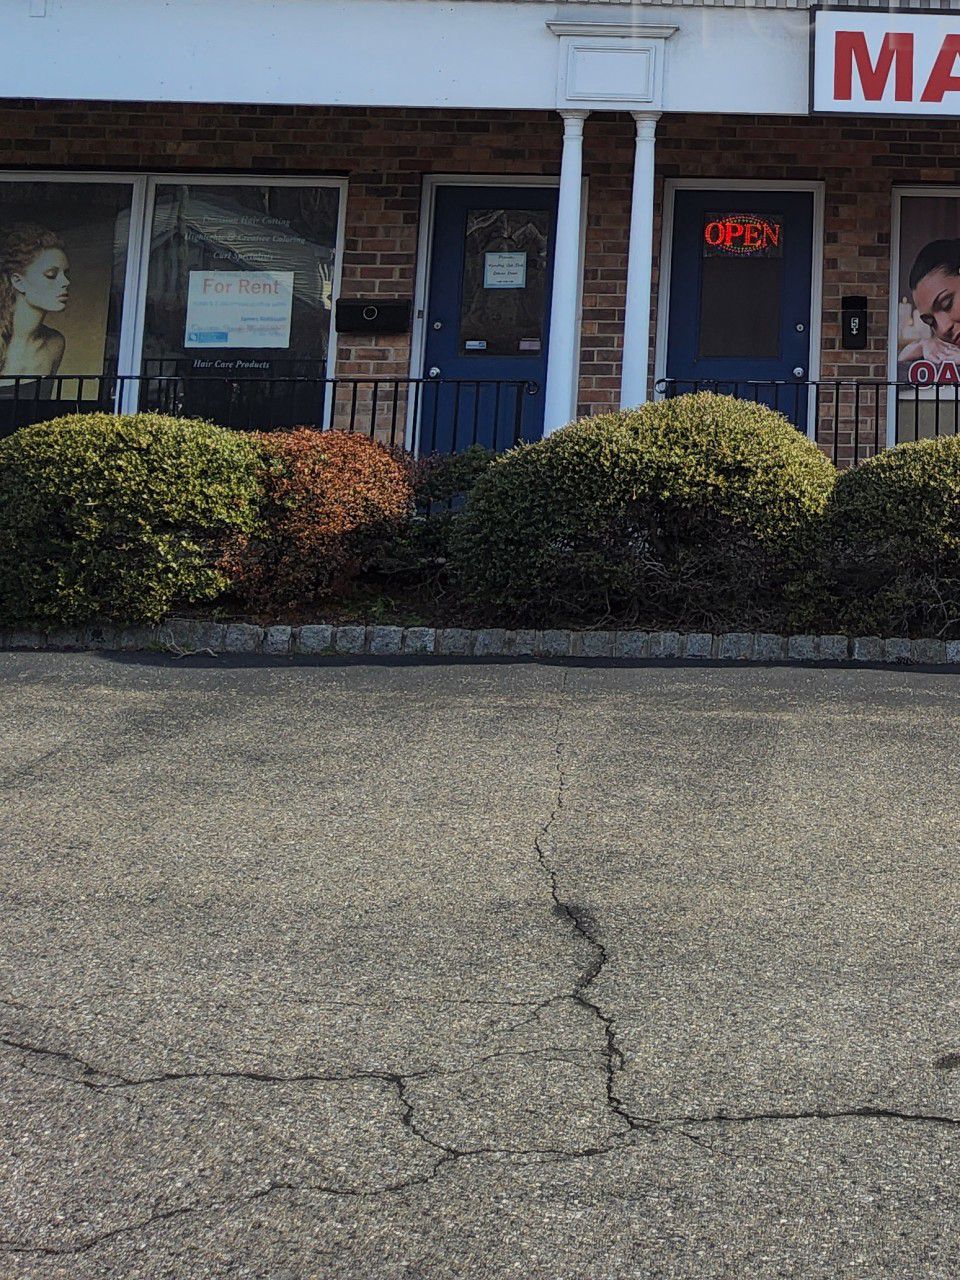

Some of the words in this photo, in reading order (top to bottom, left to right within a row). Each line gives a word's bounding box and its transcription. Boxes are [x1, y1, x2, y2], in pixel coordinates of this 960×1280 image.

[704, 222, 780, 247] OPEN
[203, 279, 232, 294] For
[239, 279, 280, 295] Rent
[193, 359, 213, 368] Hair
[214, 360, 234, 369] Care
[235, 360, 270, 369] Products
